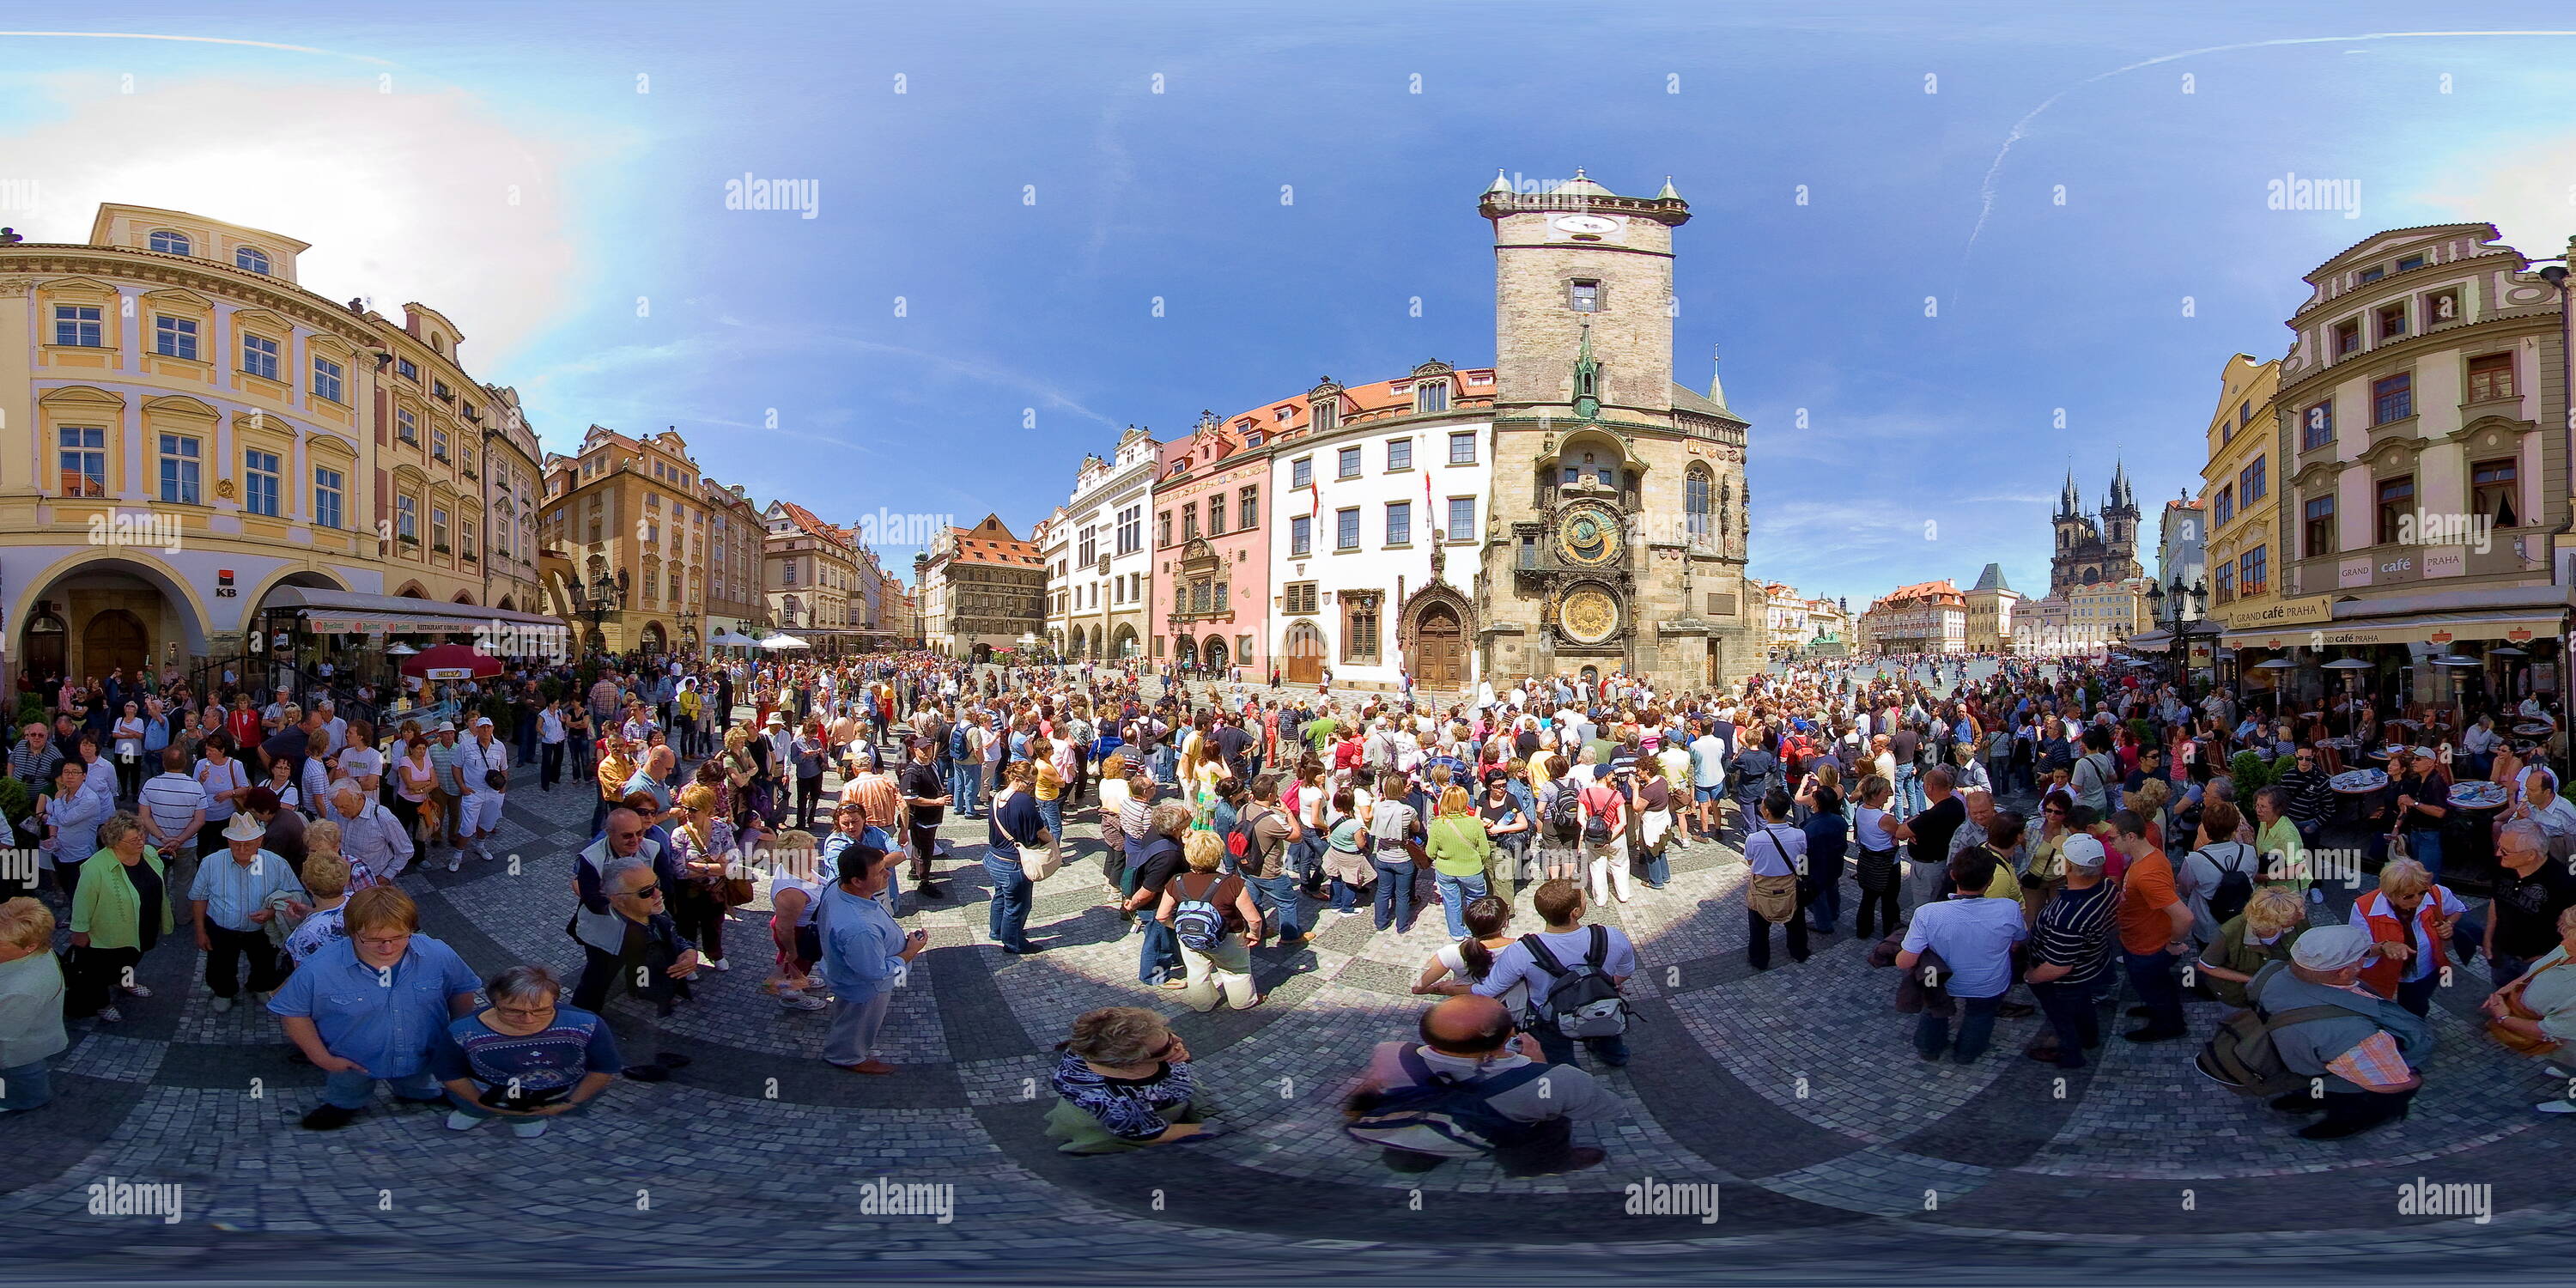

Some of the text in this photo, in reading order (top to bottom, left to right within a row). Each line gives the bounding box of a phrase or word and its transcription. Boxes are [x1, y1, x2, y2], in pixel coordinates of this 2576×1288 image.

[2342, 556, 2459, 577] GRAND café PRAHA
[216, 588, 237, 598] KB
[2237, 605, 2317, 623] GRAND café PRAHA
[2335, 634, 2354, 642] café
